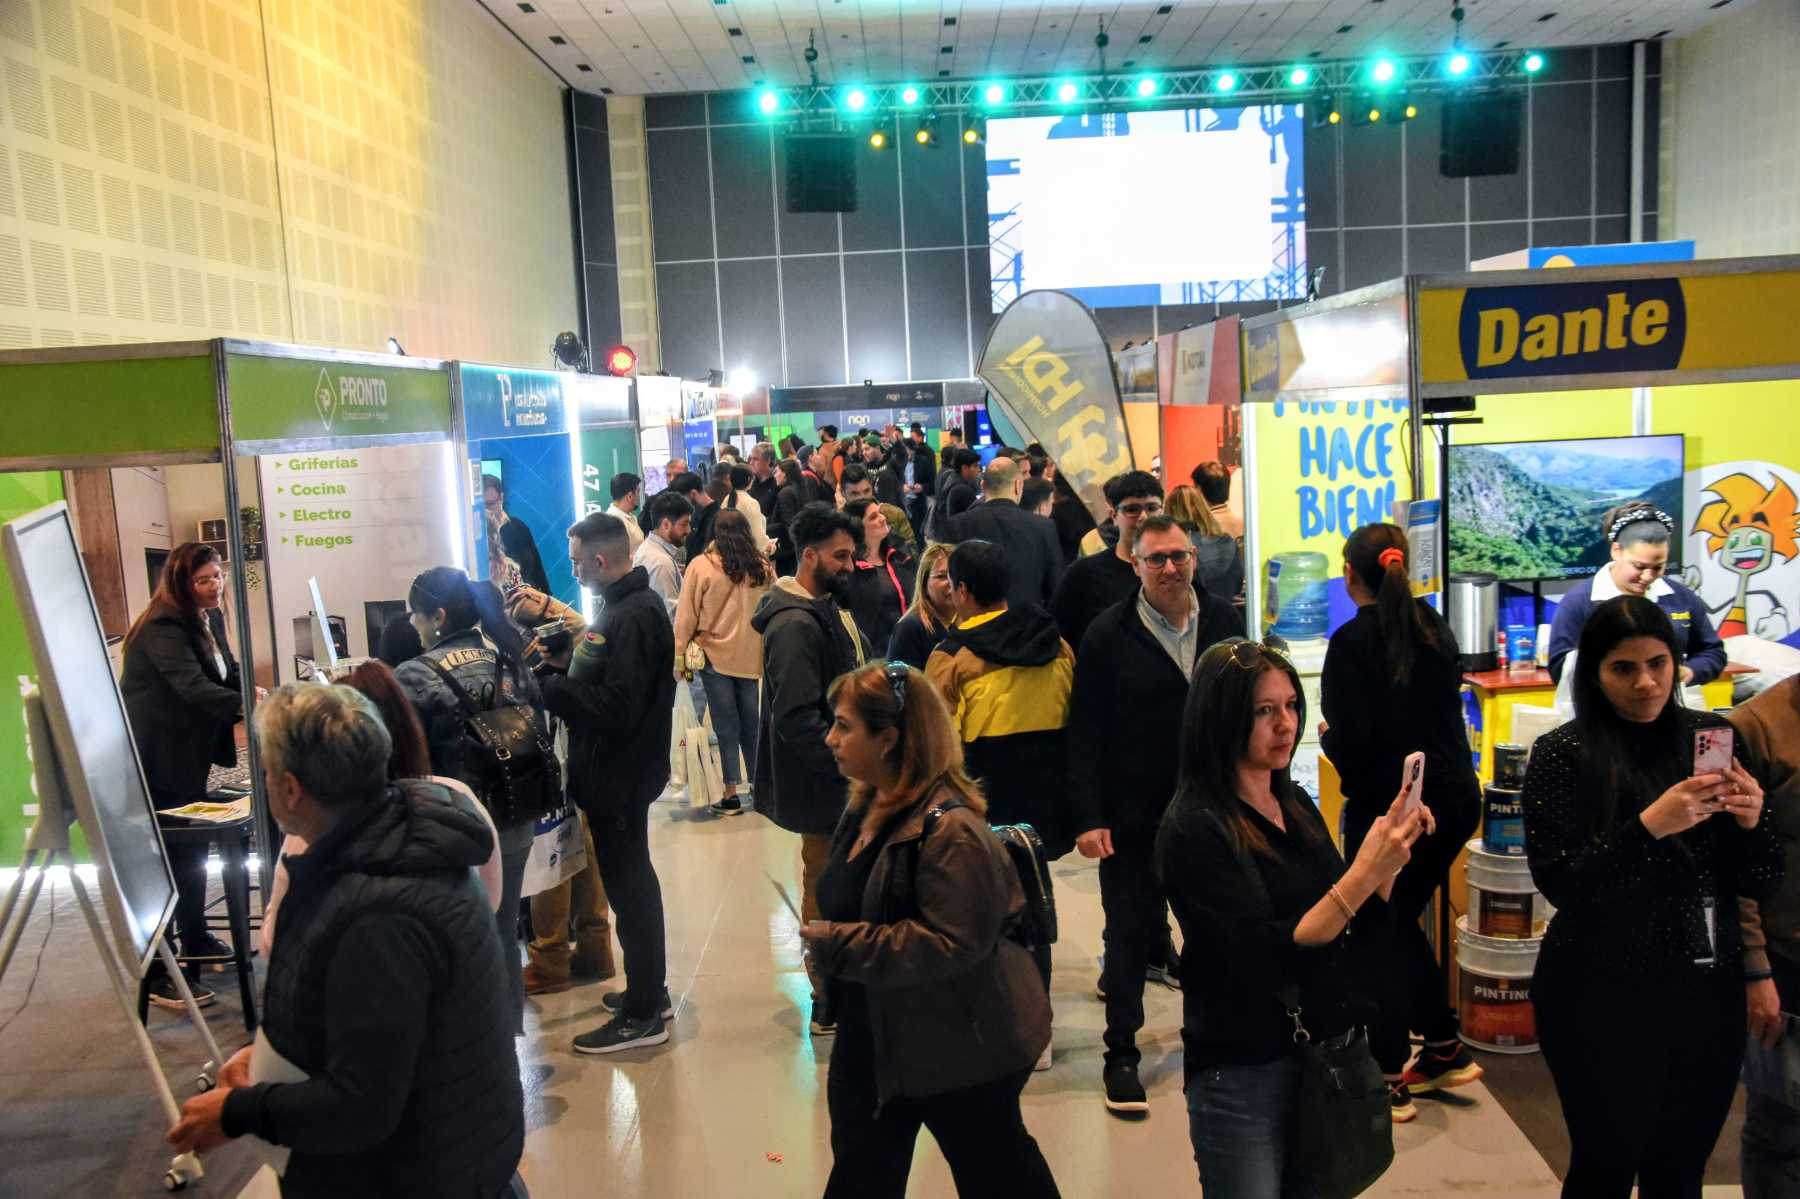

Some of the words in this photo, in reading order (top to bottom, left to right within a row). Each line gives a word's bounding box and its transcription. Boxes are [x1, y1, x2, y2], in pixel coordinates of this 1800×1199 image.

[1476, 292, 1670, 368] Dante
[339, 376, 388, 406] PRONTO
[1299, 422, 1394, 482] HACE
[290, 482, 347, 496] Cocina
[293, 508, 352, 522] Electro
[295, 533, 354, 549] Fuegos
[1490, 803, 1522, 814] PINT
